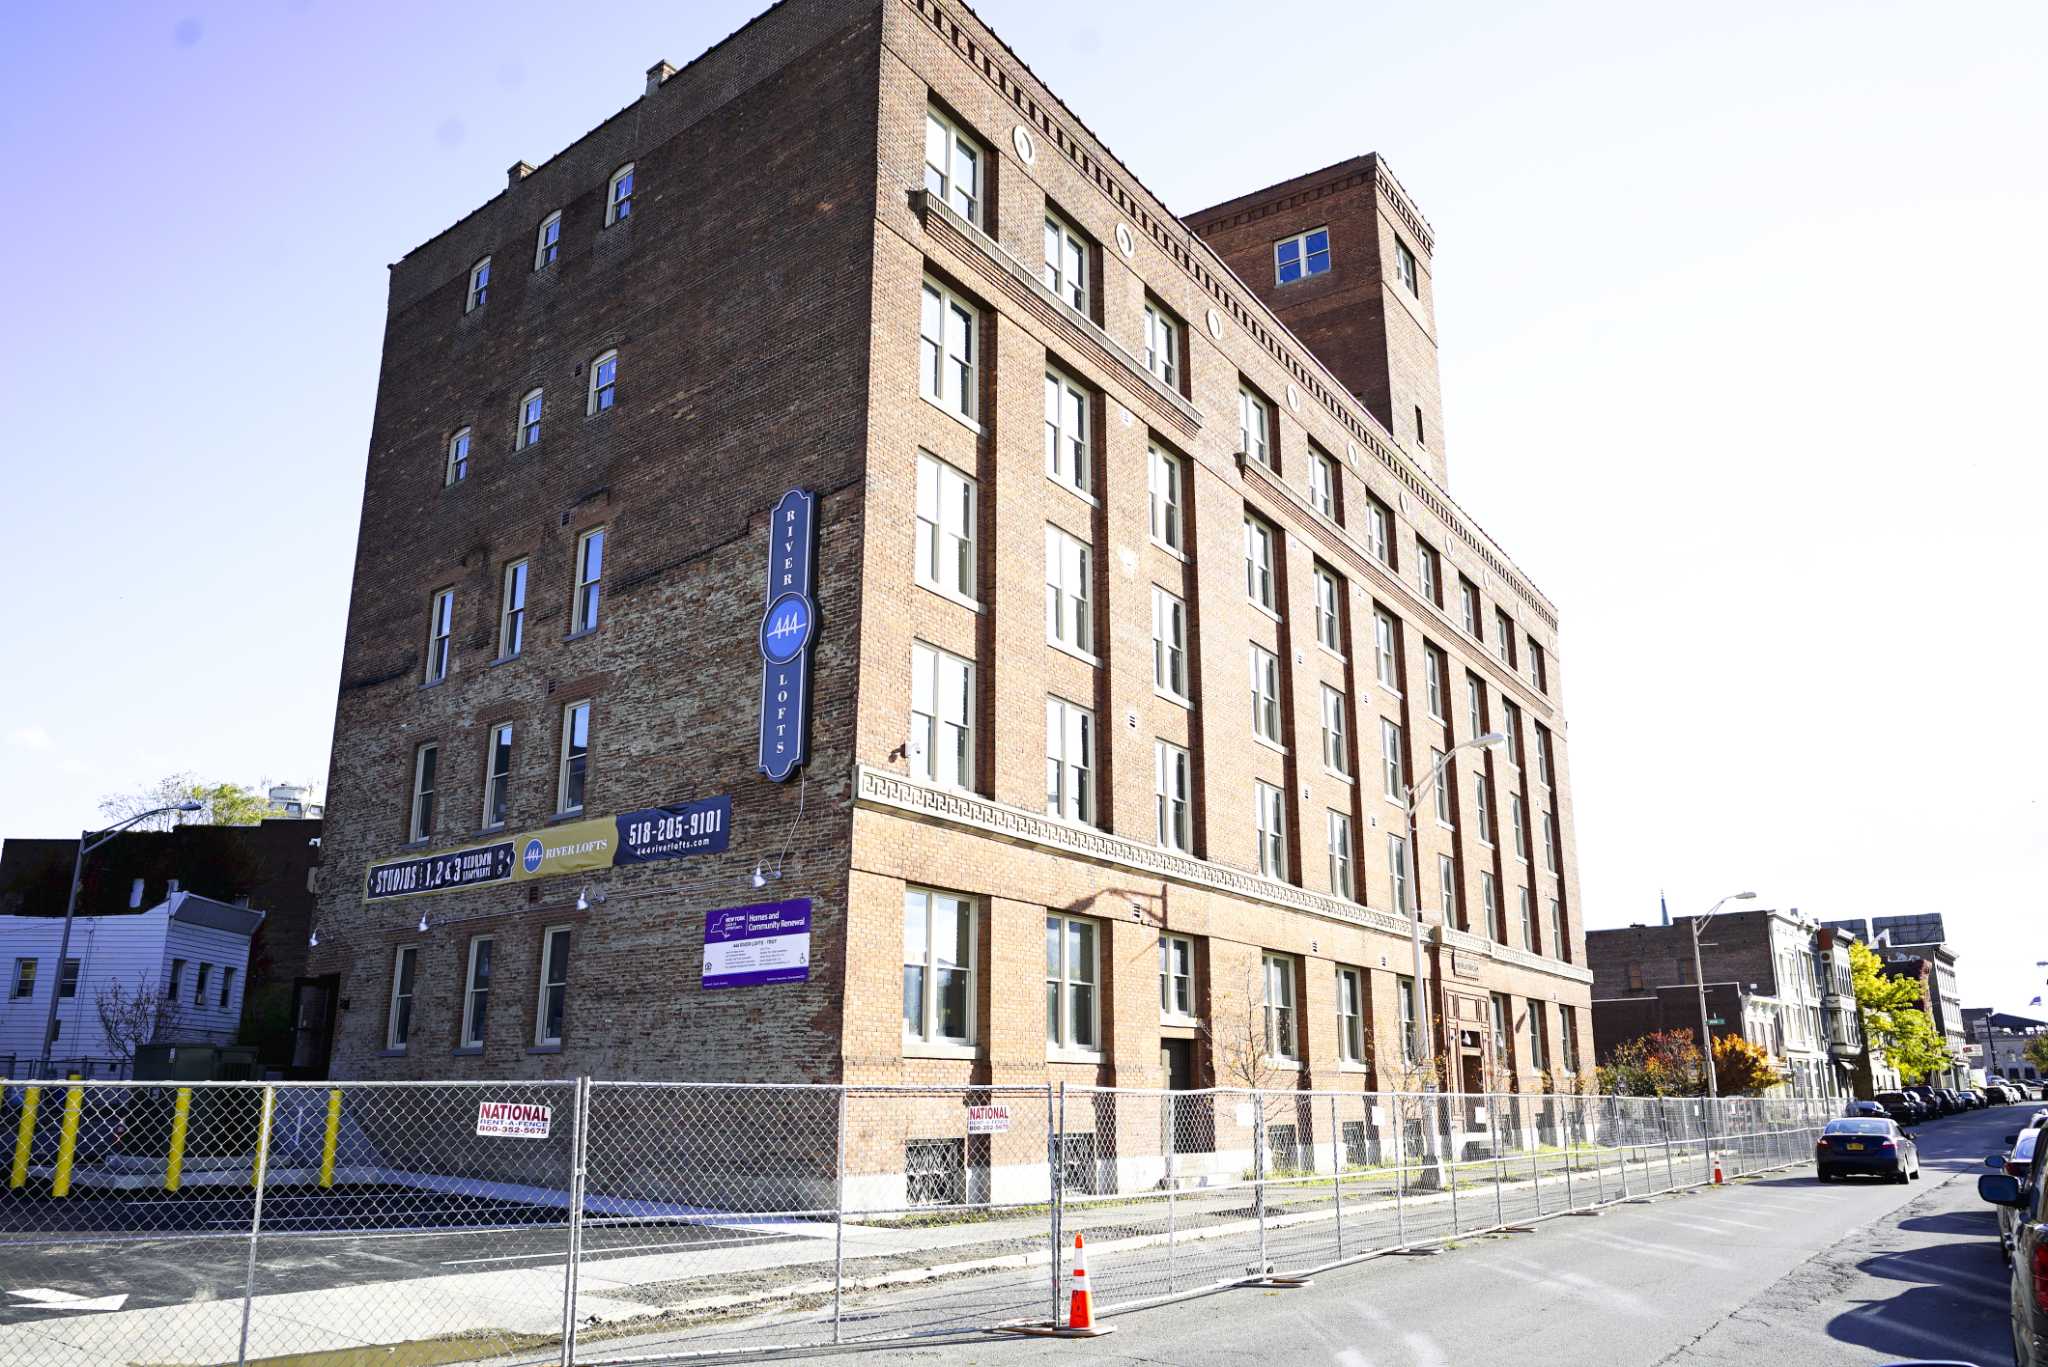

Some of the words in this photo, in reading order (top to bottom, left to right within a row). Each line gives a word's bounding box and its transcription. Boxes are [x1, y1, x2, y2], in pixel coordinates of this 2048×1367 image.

[783, 510, 796, 586] RIVER
[767, 611, 807, 640] 444
[775, 673, 788, 754] LOFTS
[628, 808, 722, 846] 518-205-9101
[545, 844, 574, 860] RIVER
[576, 839, 608, 854] LOFTS
[636, 838, 711, 856] 444riverlofts.com
[375, 865, 417, 894] STUDIOS
[453, 858, 462, 882] 3
[748, 913, 768, 922] Homes
[768, 910, 780, 920] and
[748, 920, 781, 932] Community
[781, 916, 806, 928] Renewal
[480, 1103, 548, 1121] NATIONAL
[969, 1106, 1008, 1120] NATIONAL
